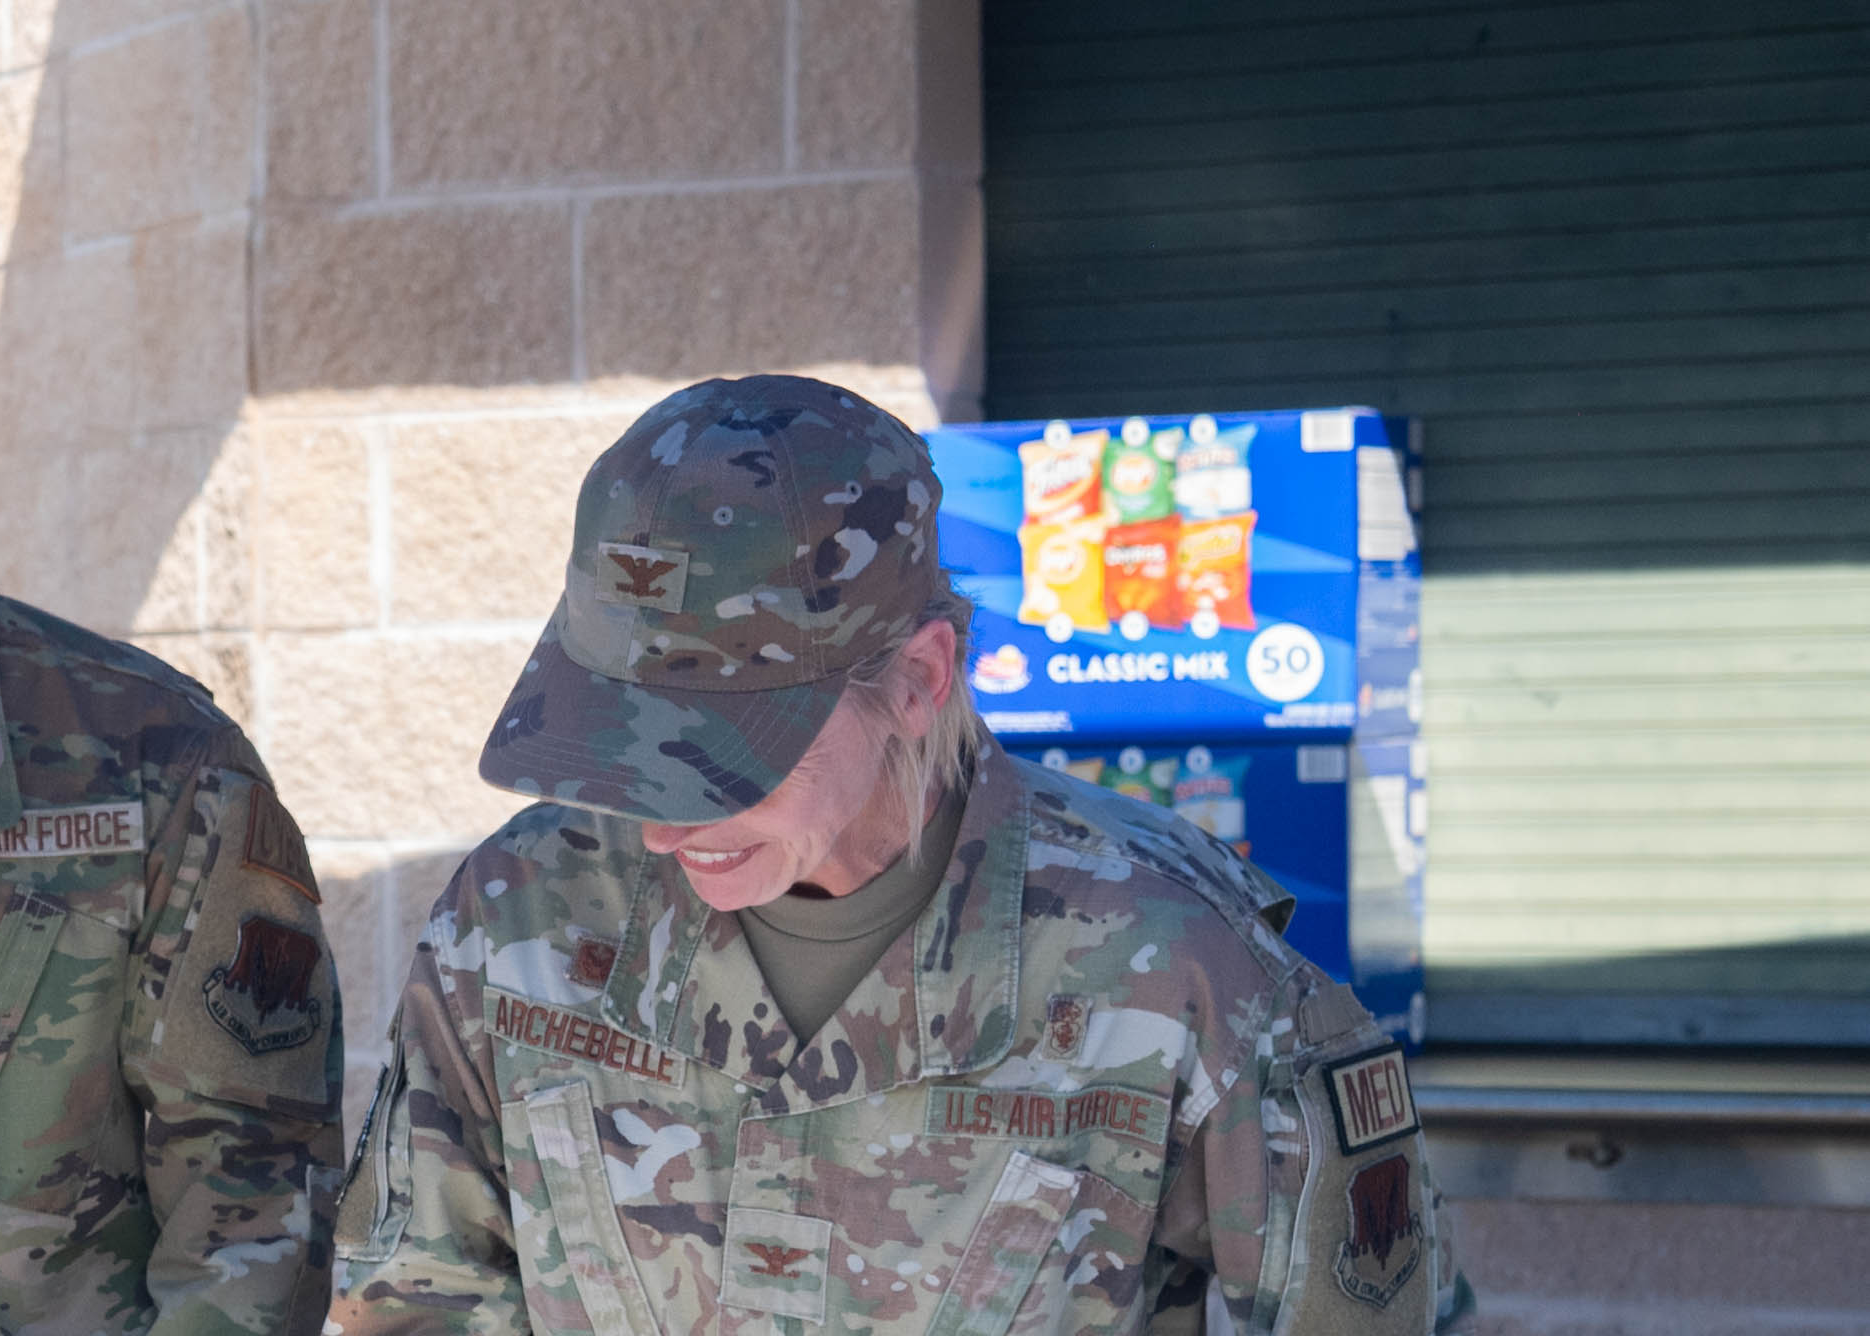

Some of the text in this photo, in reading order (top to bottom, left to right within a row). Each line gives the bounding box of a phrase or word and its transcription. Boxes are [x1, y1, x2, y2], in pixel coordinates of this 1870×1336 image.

[1047, 652, 1170, 683] CLASSIC
[1173, 650, 1229, 681] MIX
[1262, 645, 1311, 674] 50
[36, 810, 130, 850] FORCE
[495, 995, 674, 1083] ARCHEBELLE
[945, 1090, 1151, 1137] U.S. AIR FORCE
[1343, 1059, 1405, 1138] MED
